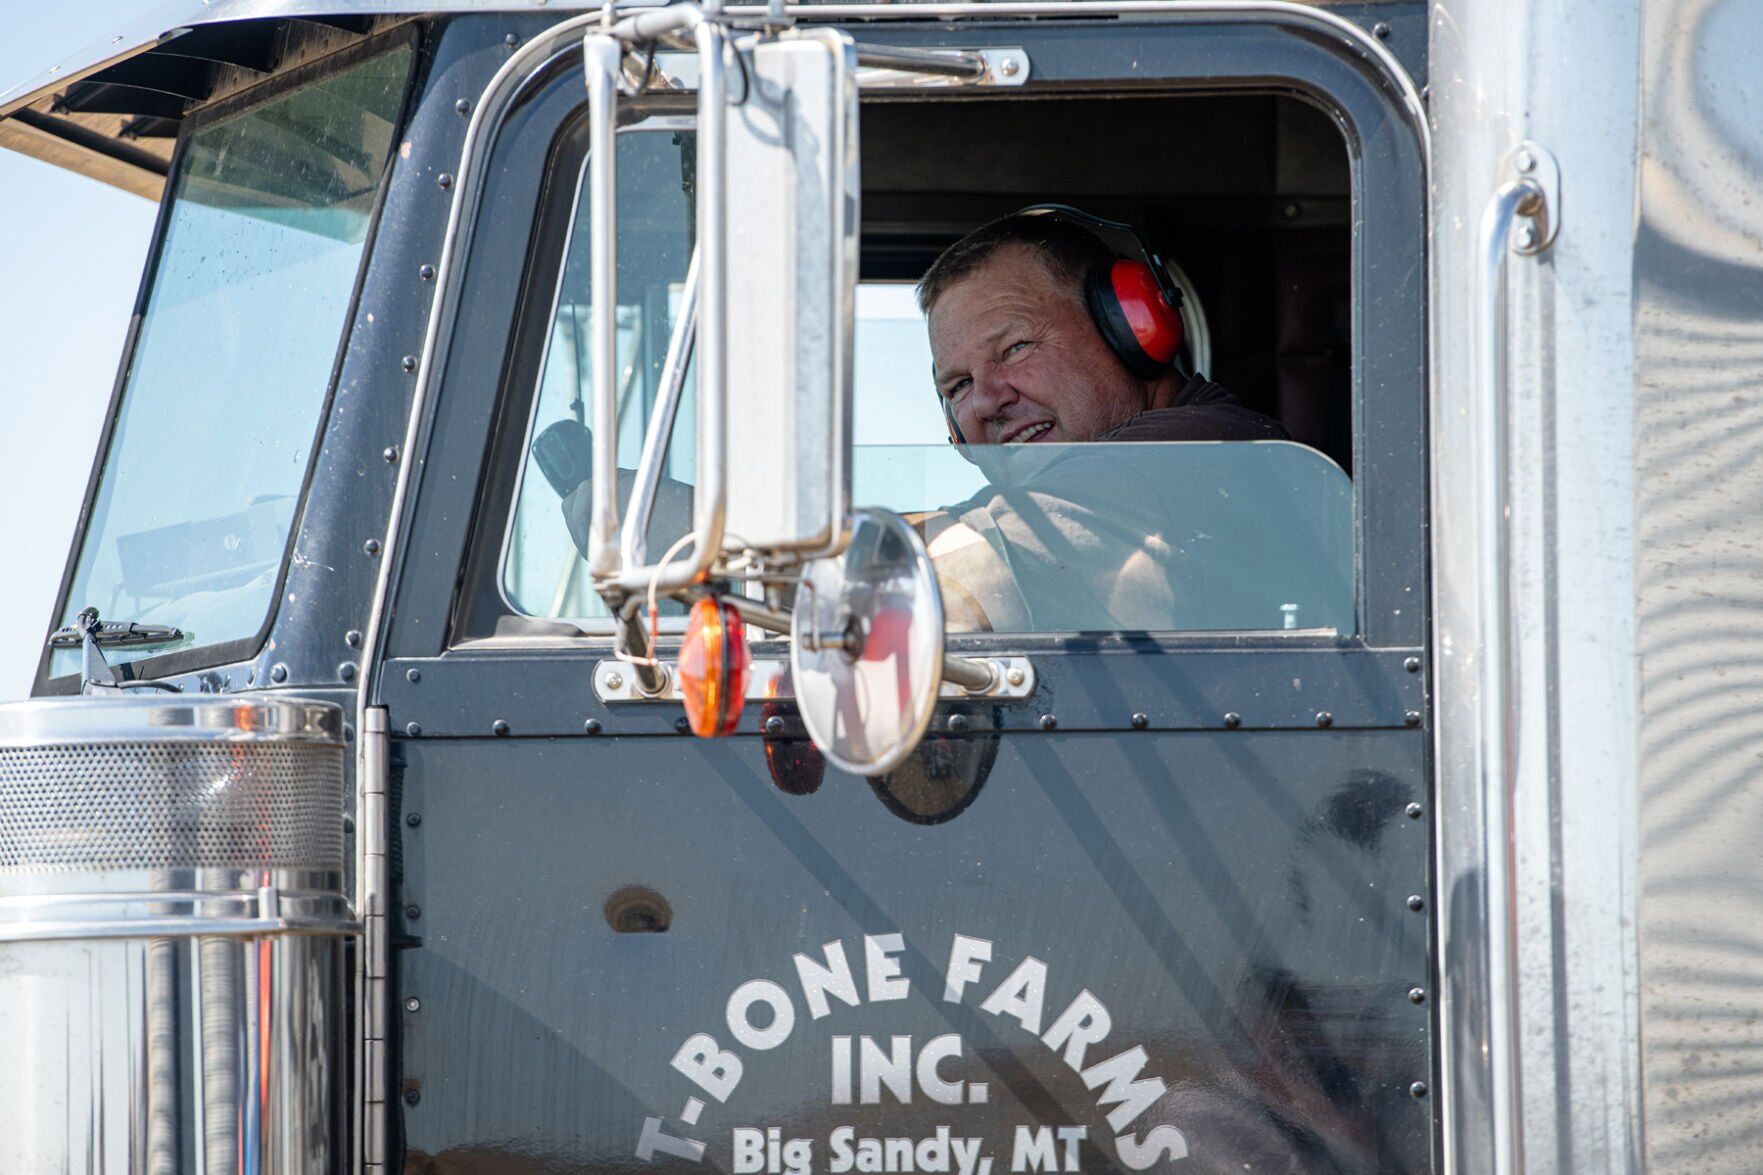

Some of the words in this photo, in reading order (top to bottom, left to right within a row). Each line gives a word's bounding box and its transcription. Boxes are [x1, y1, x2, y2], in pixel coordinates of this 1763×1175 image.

[635, 932, 910, 1163] T-BONE
[942, 932, 1189, 1171] FARMS
[831, 1033, 989, 1105] INC.
[732, 1126, 813, 1175] Big
[829, 1125, 995, 1175] Sandy,
[1011, 1125, 1088, 1172] MT
